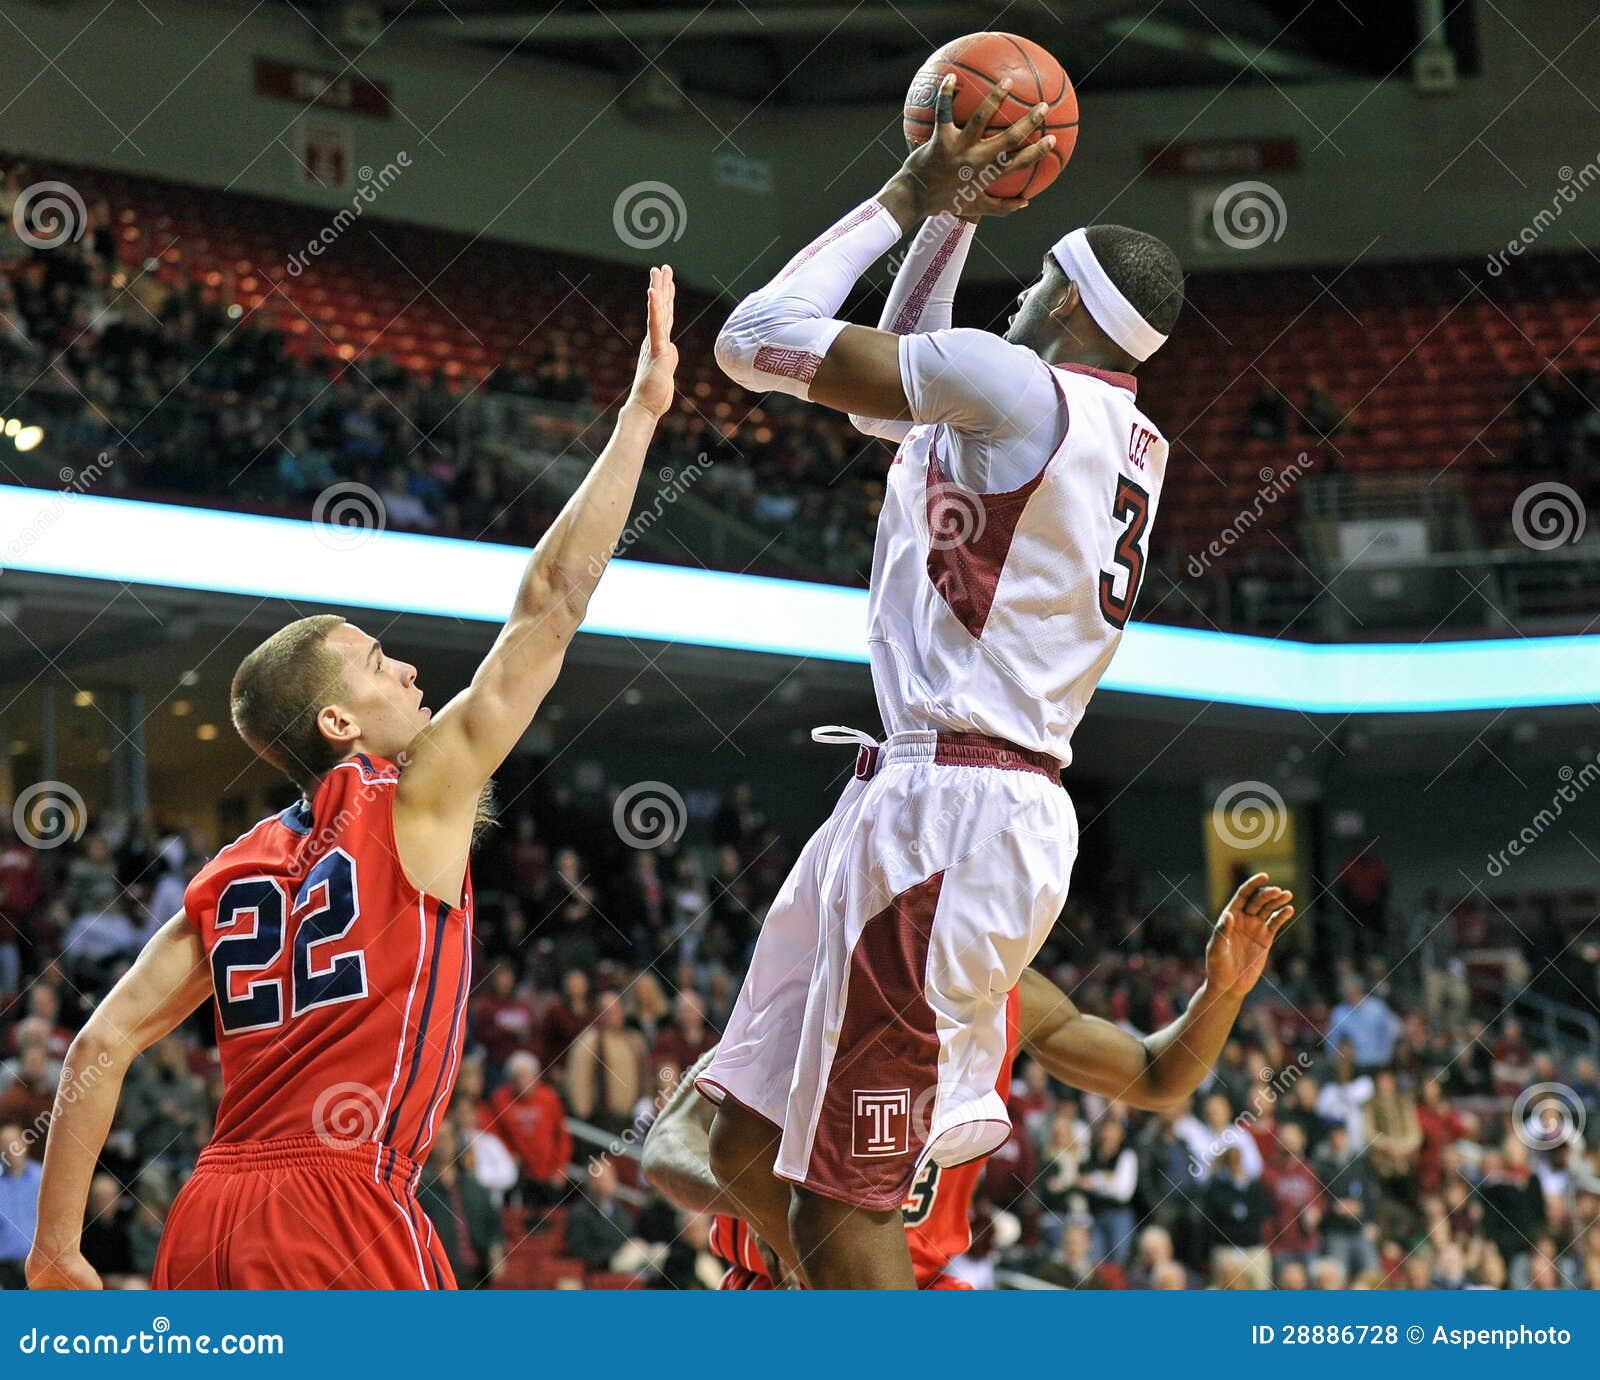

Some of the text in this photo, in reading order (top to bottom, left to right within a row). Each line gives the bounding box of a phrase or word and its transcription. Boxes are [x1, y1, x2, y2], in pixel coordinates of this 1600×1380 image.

[1129, 422, 1158, 471] LEE
[1099, 472, 1150, 630] 3
[210, 846, 369, 1036] 22
